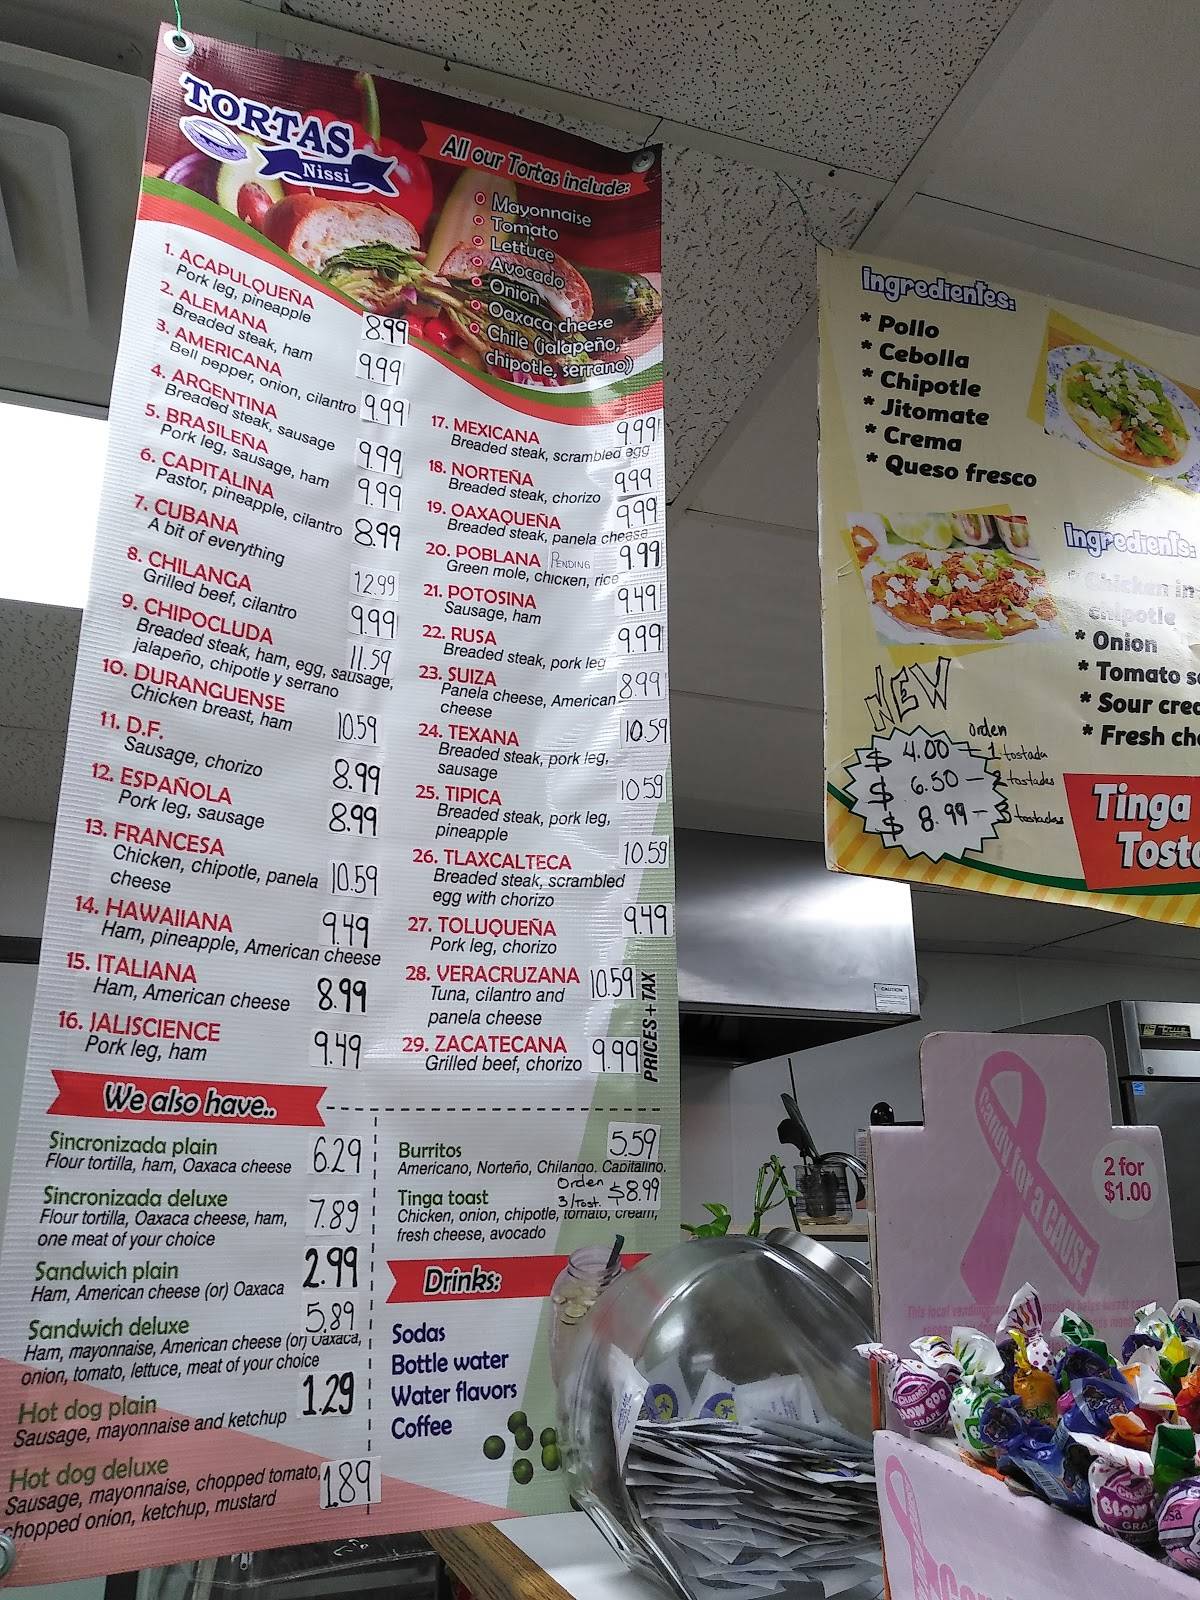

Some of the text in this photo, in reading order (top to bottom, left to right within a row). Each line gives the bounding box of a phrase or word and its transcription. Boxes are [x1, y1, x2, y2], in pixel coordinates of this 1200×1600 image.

[185, 76, 351, 159] TORTAS
[302, 162, 350, 184] Nissi
[441, 136, 631, 196] All our Tortas include:
[492, 194, 592, 227] Mayonnaise
[491, 217, 559, 240] Tomato
[491, 237, 555, 263] Lettuce
[164, 243, 314, 309] 1. ACAPULQUEÑA
[490, 258, 564, 289] Avocado
[176, 264, 312, 323] Pork leg, pineapple
[490, 279, 540, 306] Onion
[862, 266, 1016, 311] Ingredientes:
[160, 281, 268, 333] 2. ALEMANA
[489, 302, 613, 333] Oaxaca cheese
[172, 302, 313, 361] Breaded steak, ham
[365, 315, 407, 344] 8.99
[487, 326, 620, 356] Chile (jalapeño,
[878, 315, 940, 340] Pollo
[359, 353, 401, 385] 9.99
[485, 350, 634, 378] chipotle, serrano)
[879, 343, 970, 369] Cebolla
[879, 371, 982, 399] Chipotle
[880, 399, 990, 426] Jitomate
[431, 415, 540, 444] 17. MEXICANA
[617, 417, 656, 445] 9.99
[883, 426, 963, 452] Crema
[141, 448, 275, 499] 6. CAPITALINA
[429, 460, 534, 486] 18. NORTEÑA
[615, 468, 652, 493] 9.99
[885, 455, 1038, 488] Queso fresco
[358, 478, 401, 511] 9.99
[449, 477, 601, 505] Breaded steak, chorizo
[134, 495, 239, 535] 7. CUBANA
[147, 518, 286, 568] A bit of everything
[425, 542, 541, 568] 20. POBLANA
[620, 540, 660, 570] 9.99
[127, 547, 252, 592] 8. CHILANGA
[355, 571, 395, 597] 12.99
[143, 568, 297, 619] Grilled beef, cilantro
[351, 605, 395, 638] 9.99
[422, 624, 497, 645] 22. RUSA
[618, 623, 662, 654] 9.99
[1093, 631, 1157, 653] Onion
[103, 658, 286, 713] 10. DURANGUENSE
[1097, 661, 1180, 684] Tomato
[131, 683, 293, 731] Chicken breast, ham
[864, 656, 951, 732] NEW
[1098, 692, 1153, 714] Sour
[100, 711, 164, 740] 11. D.F.
[338, 712, 377, 743] 10.59
[969, 718, 1007, 737] orden
[1101, 725, 1164, 746] Fresh
[124, 737, 263, 778] Sausage, chorizo
[903, 739, 949, 762] 4.00
[92, 762, 233, 805] 12. ESPAÑOLA
[333, 759, 380, 795] 8.99
[911, 769, 959, 795] 6.50
[329, 803, 377, 836] 8.99
[919, 802, 968, 832] 8.99
[1092, 782, 1191, 830] Tinga
[412, 849, 573, 870] 26. TLAXCALTECA
[623, 841, 668, 865] 10.59
[408, 917, 557, 937] 27. TOLUQUEÑA
[624, 905, 667, 935] 9.49
[430, 936, 557, 956] Pork leg, chorizo
[67, 952, 198, 983] 15. ITALIANA
[405, 965, 581, 984] 28. VERACRUZANA
[93, 977, 290, 1011] Ham, American cheese
[318, 978, 367, 1013] 8.99
[591, 967, 634, 999] 10.59
[641, 972, 656, 1001] TAX
[60, 1011, 220, 1042] 16. JALISCIENCE
[85, 1035, 207, 1062] Pork leg, ham
[314, 1031, 361, 1068] 9.49
[402, 1035, 568, 1054] 29. ZACATECANA
[592, 1038, 639, 1073] 9.99
[642, 1019, 658, 1082] PRICES
[425, 1055, 583, 1073] Grilled beef, chorizo
[104, 1083, 276, 1116] We also have..
[49, 1131, 218, 1158] Sincronizada plain
[314, 1136, 362, 1175] 6.29
[398, 1142, 462, 1158] Burritos
[610, 1128, 657, 1159] 5.59
[1104, 1156, 1145, 1177] 2 for
[43, 1185, 228, 1208] Sincronizada deluxe
[398, 1190, 488, 1209] Tinga toast
[1104, 1181, 1151, 1203] $1.00
[309, 1198, 359, 1233] 7.89
[35, 1261, 179, 1283] Sandwich plain
[303, 1246, 358, 1289] 2.99
[424, 1267, 501, 1293] Drinks:
[392, 1322, 446, 1344] Sodas
[392, 1351, 509, 1375] Bottle water
[302, 1371, 354, 1416] 1.29
[391, 1381, 518, 1407] Water flavors
[19, 1395, 157, 1424] Hot dog plain
[914, 1410, 940, 1426] GRAPE
[391, 1417, 453, 1439] Coffee
[1101, 1497, 1148, 1519] BLOW
